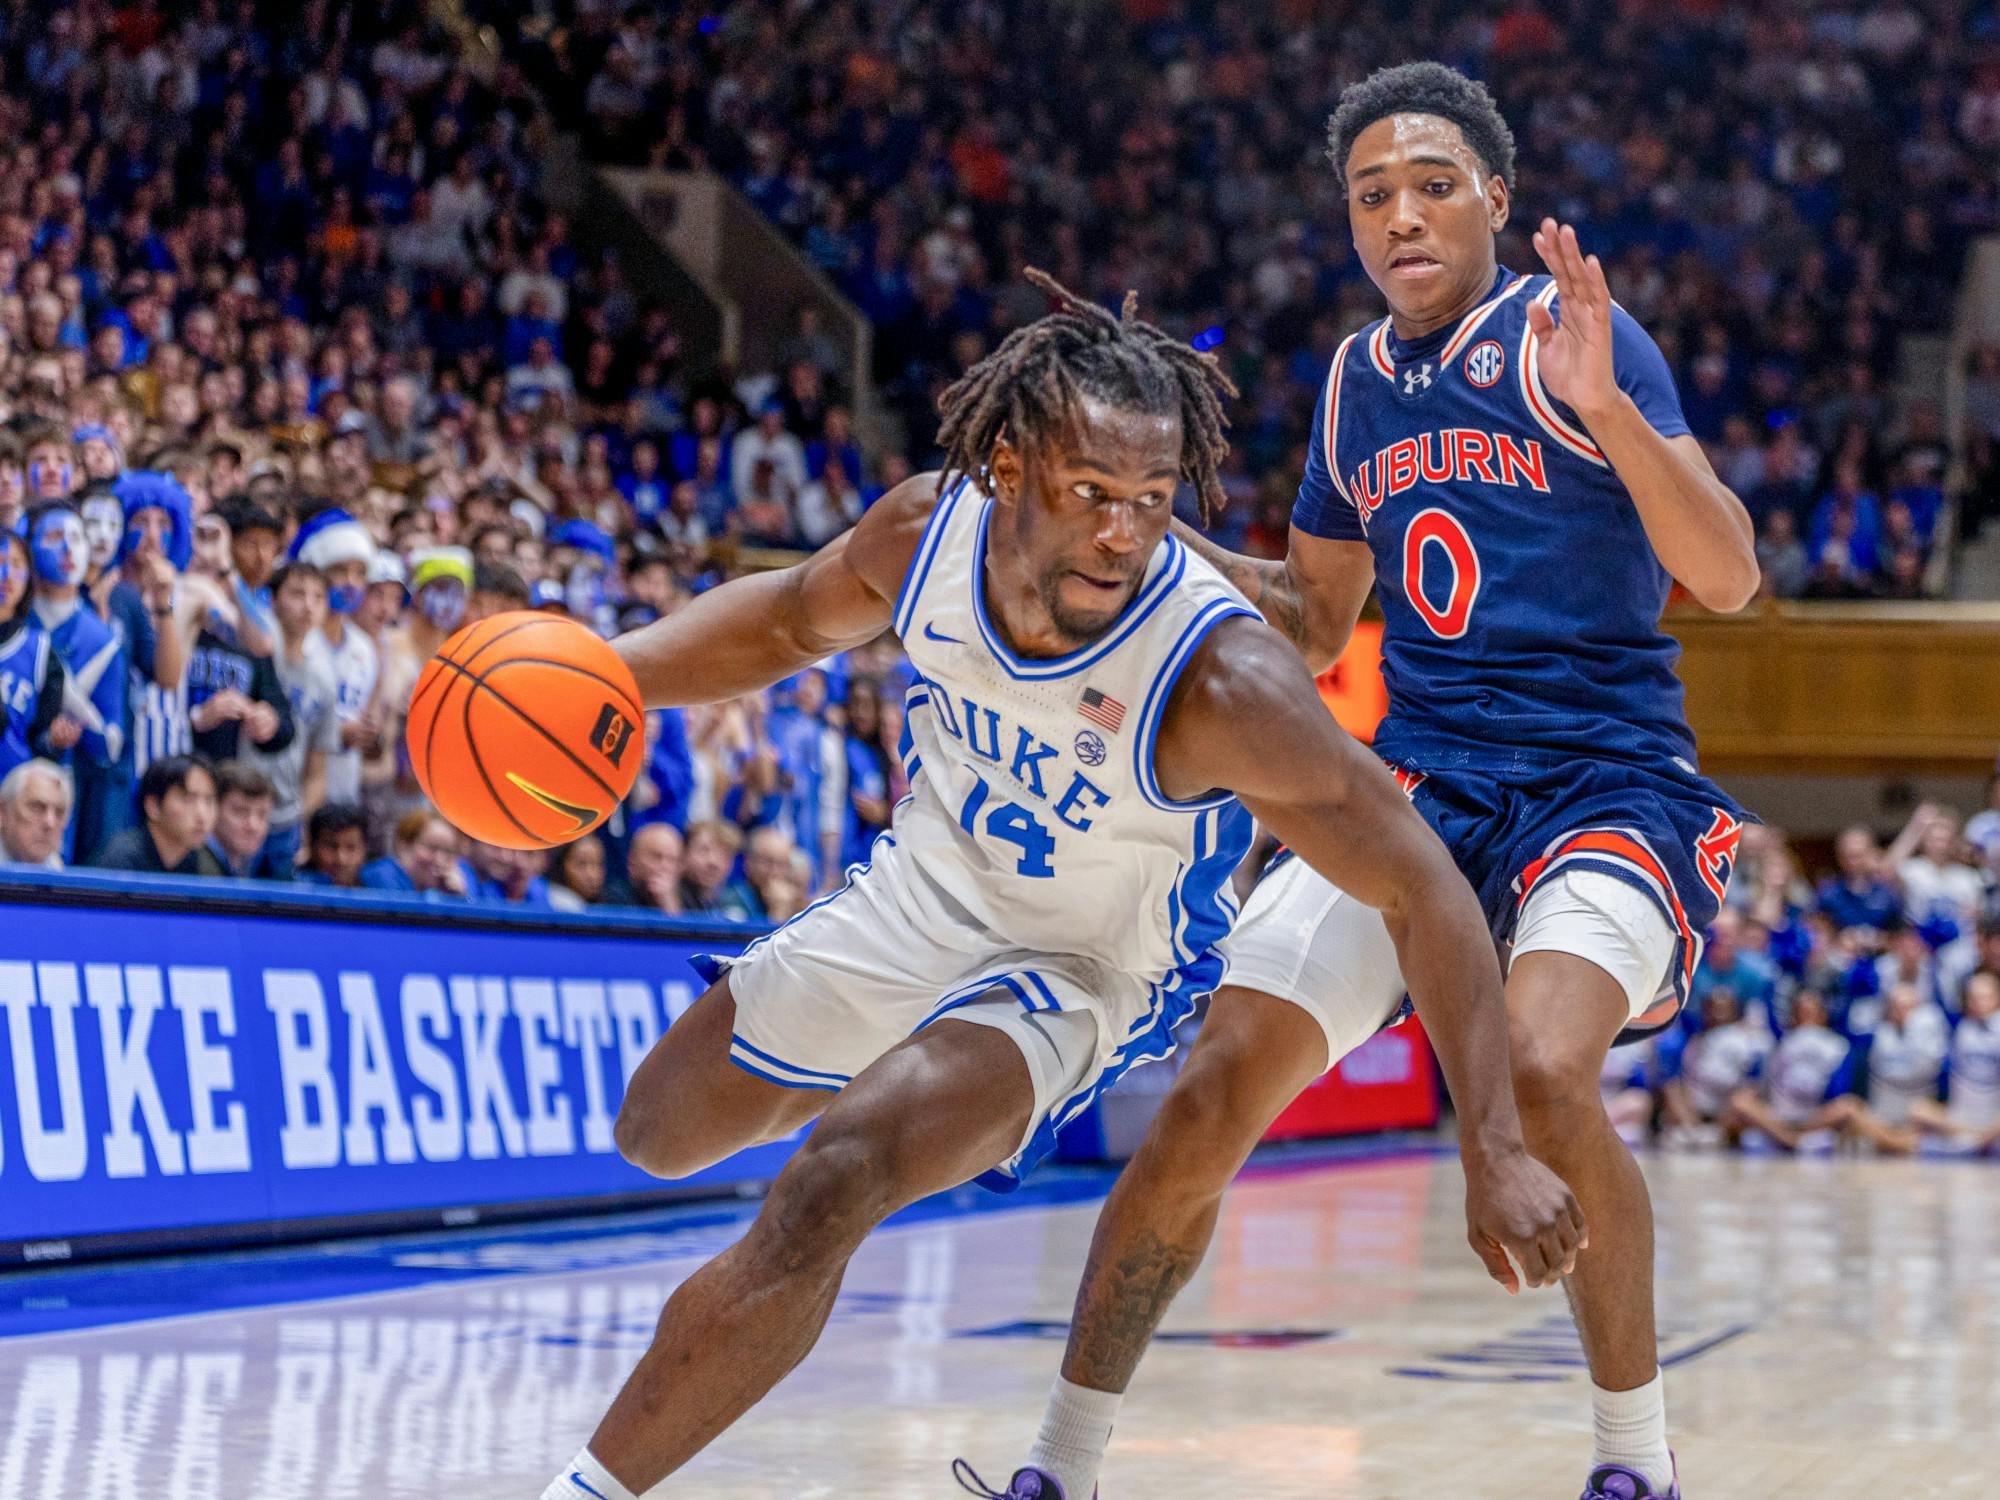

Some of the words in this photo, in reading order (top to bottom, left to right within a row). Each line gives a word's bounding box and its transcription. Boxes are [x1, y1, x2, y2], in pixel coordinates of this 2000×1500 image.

[1468, 344, 1501, 384] SEC
[1403, 507, 1481, 640] 0
[925, 677, 1111, 833] DUKE
[961, 764, 1056, 879] 14
[0, 958, 252, 1182] UKE
[262, 967, 706, 1170] BASKET
